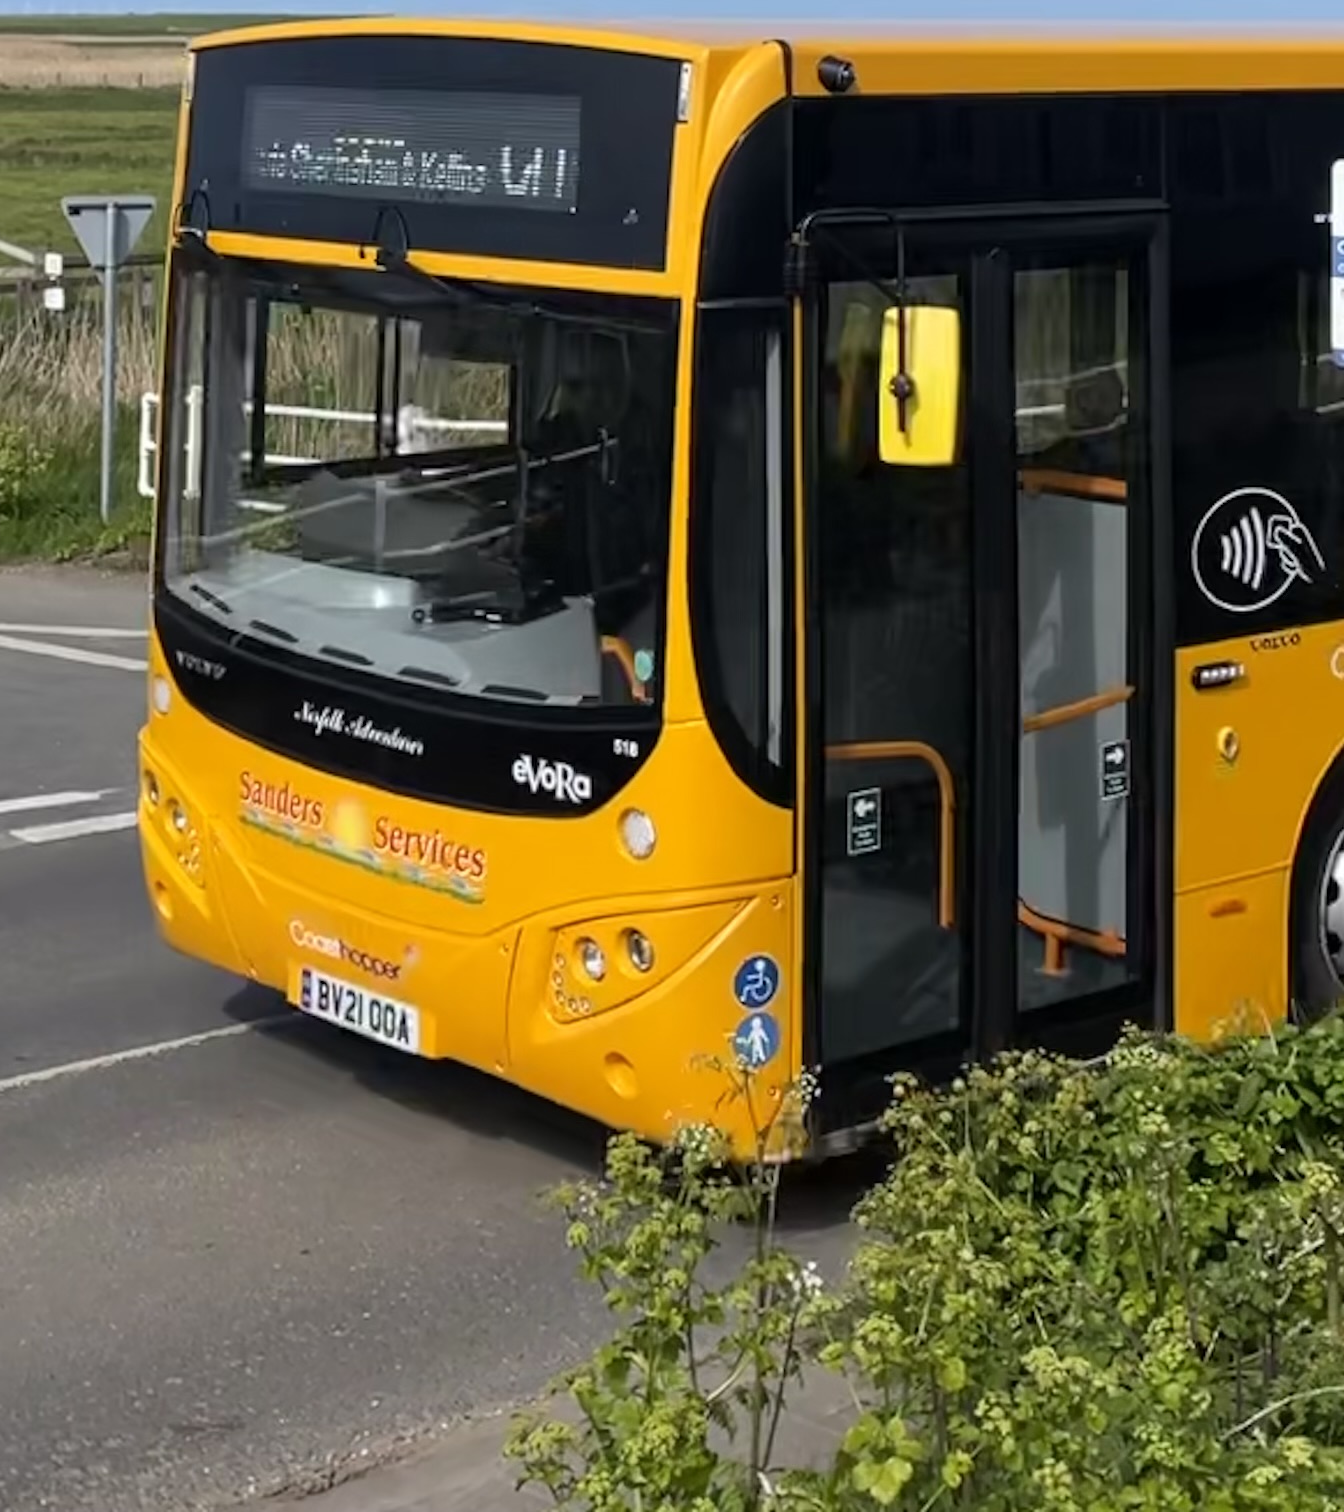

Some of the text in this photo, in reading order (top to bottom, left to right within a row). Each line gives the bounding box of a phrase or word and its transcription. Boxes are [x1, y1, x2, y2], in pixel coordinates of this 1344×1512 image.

[239, 771, 487, 879] Sanders Services
[317, 979, 363, 1026] BV21
